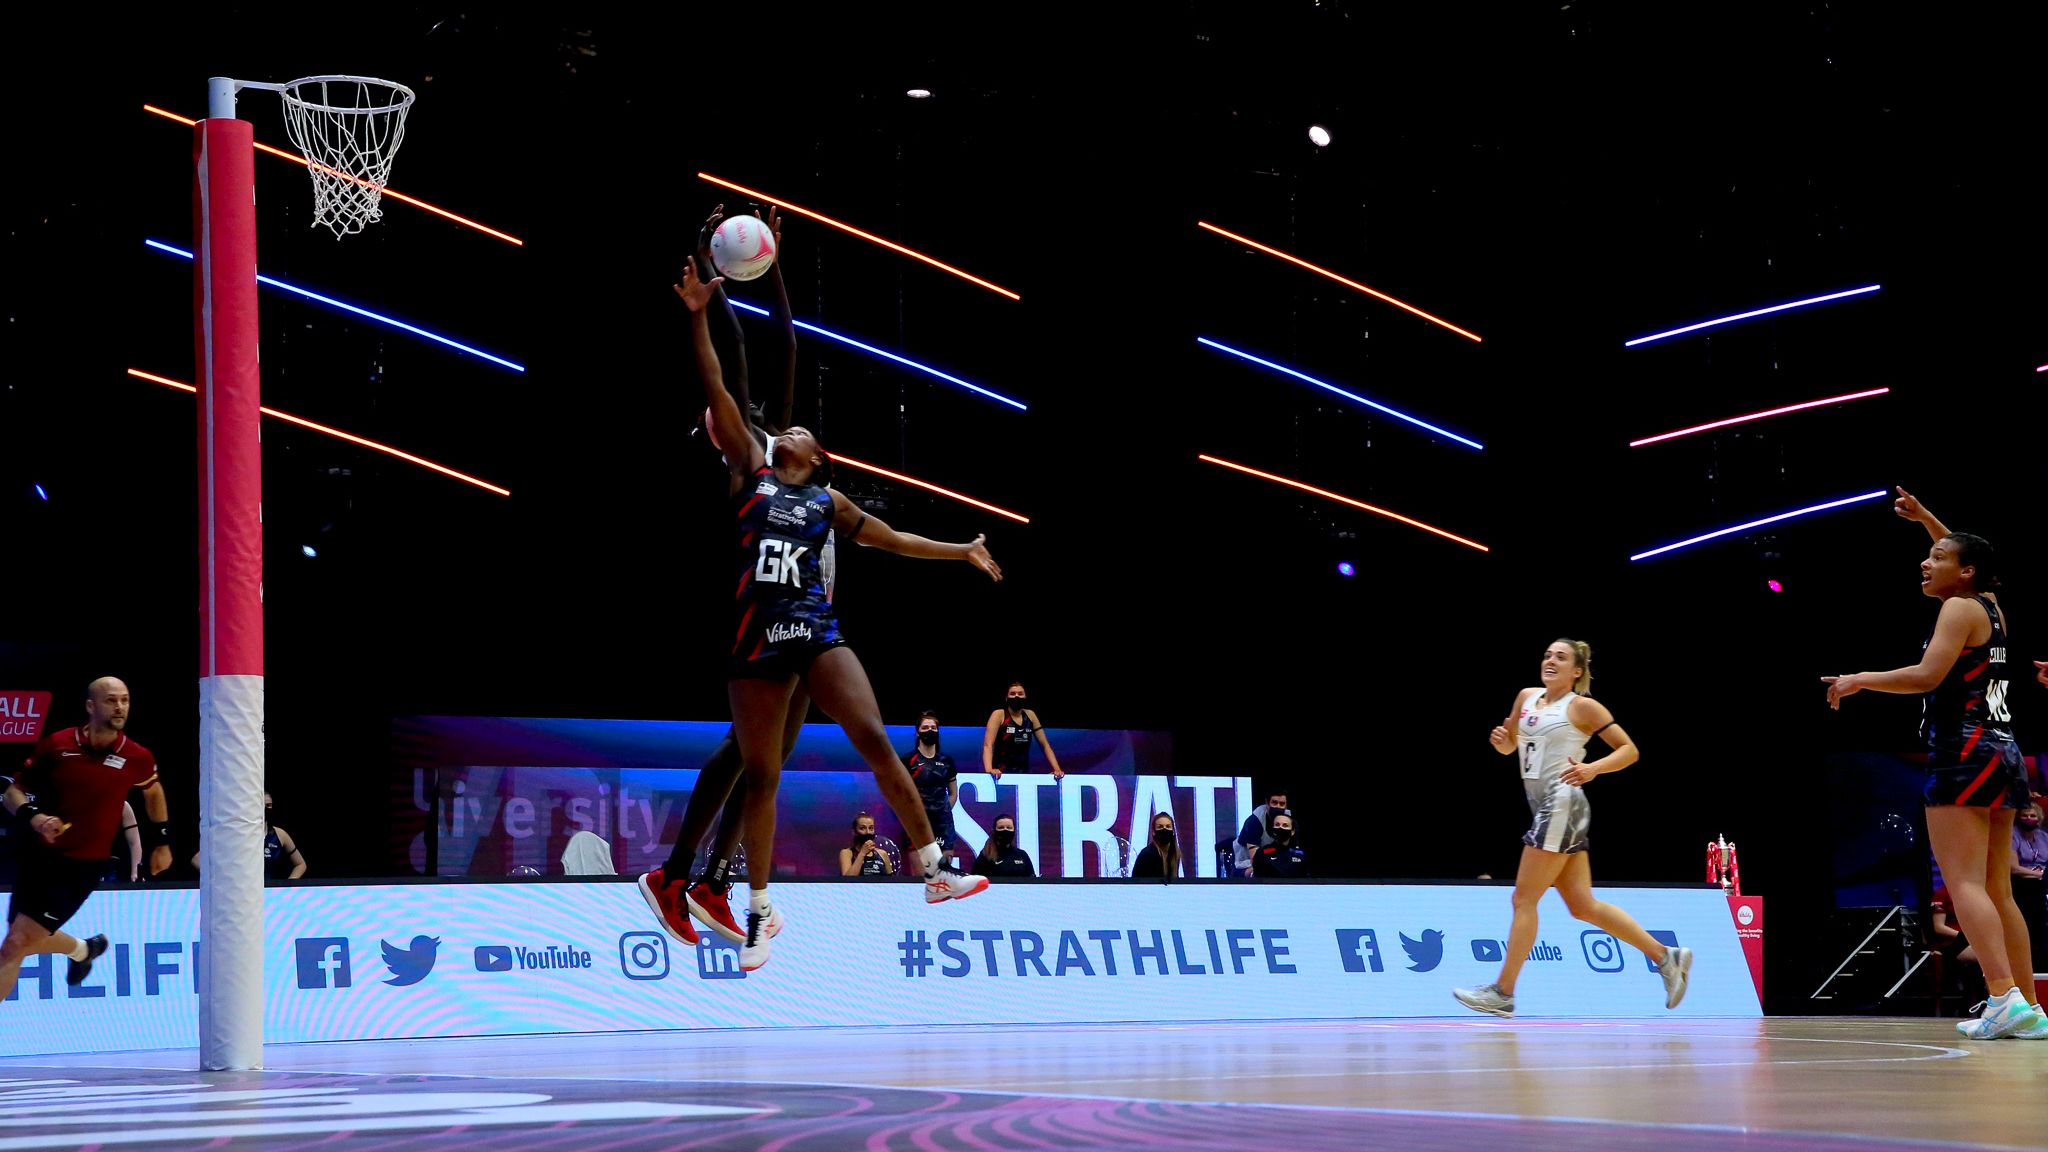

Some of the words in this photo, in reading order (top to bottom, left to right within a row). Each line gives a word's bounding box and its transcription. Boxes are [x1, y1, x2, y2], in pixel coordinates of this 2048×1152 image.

[755, 538, 809, 588] GK
[765, 622, 812, 643] Vitality
[514, 944, 592, 970] YouTube
[898, 928, 1298, 978] #STRATHLIFE
